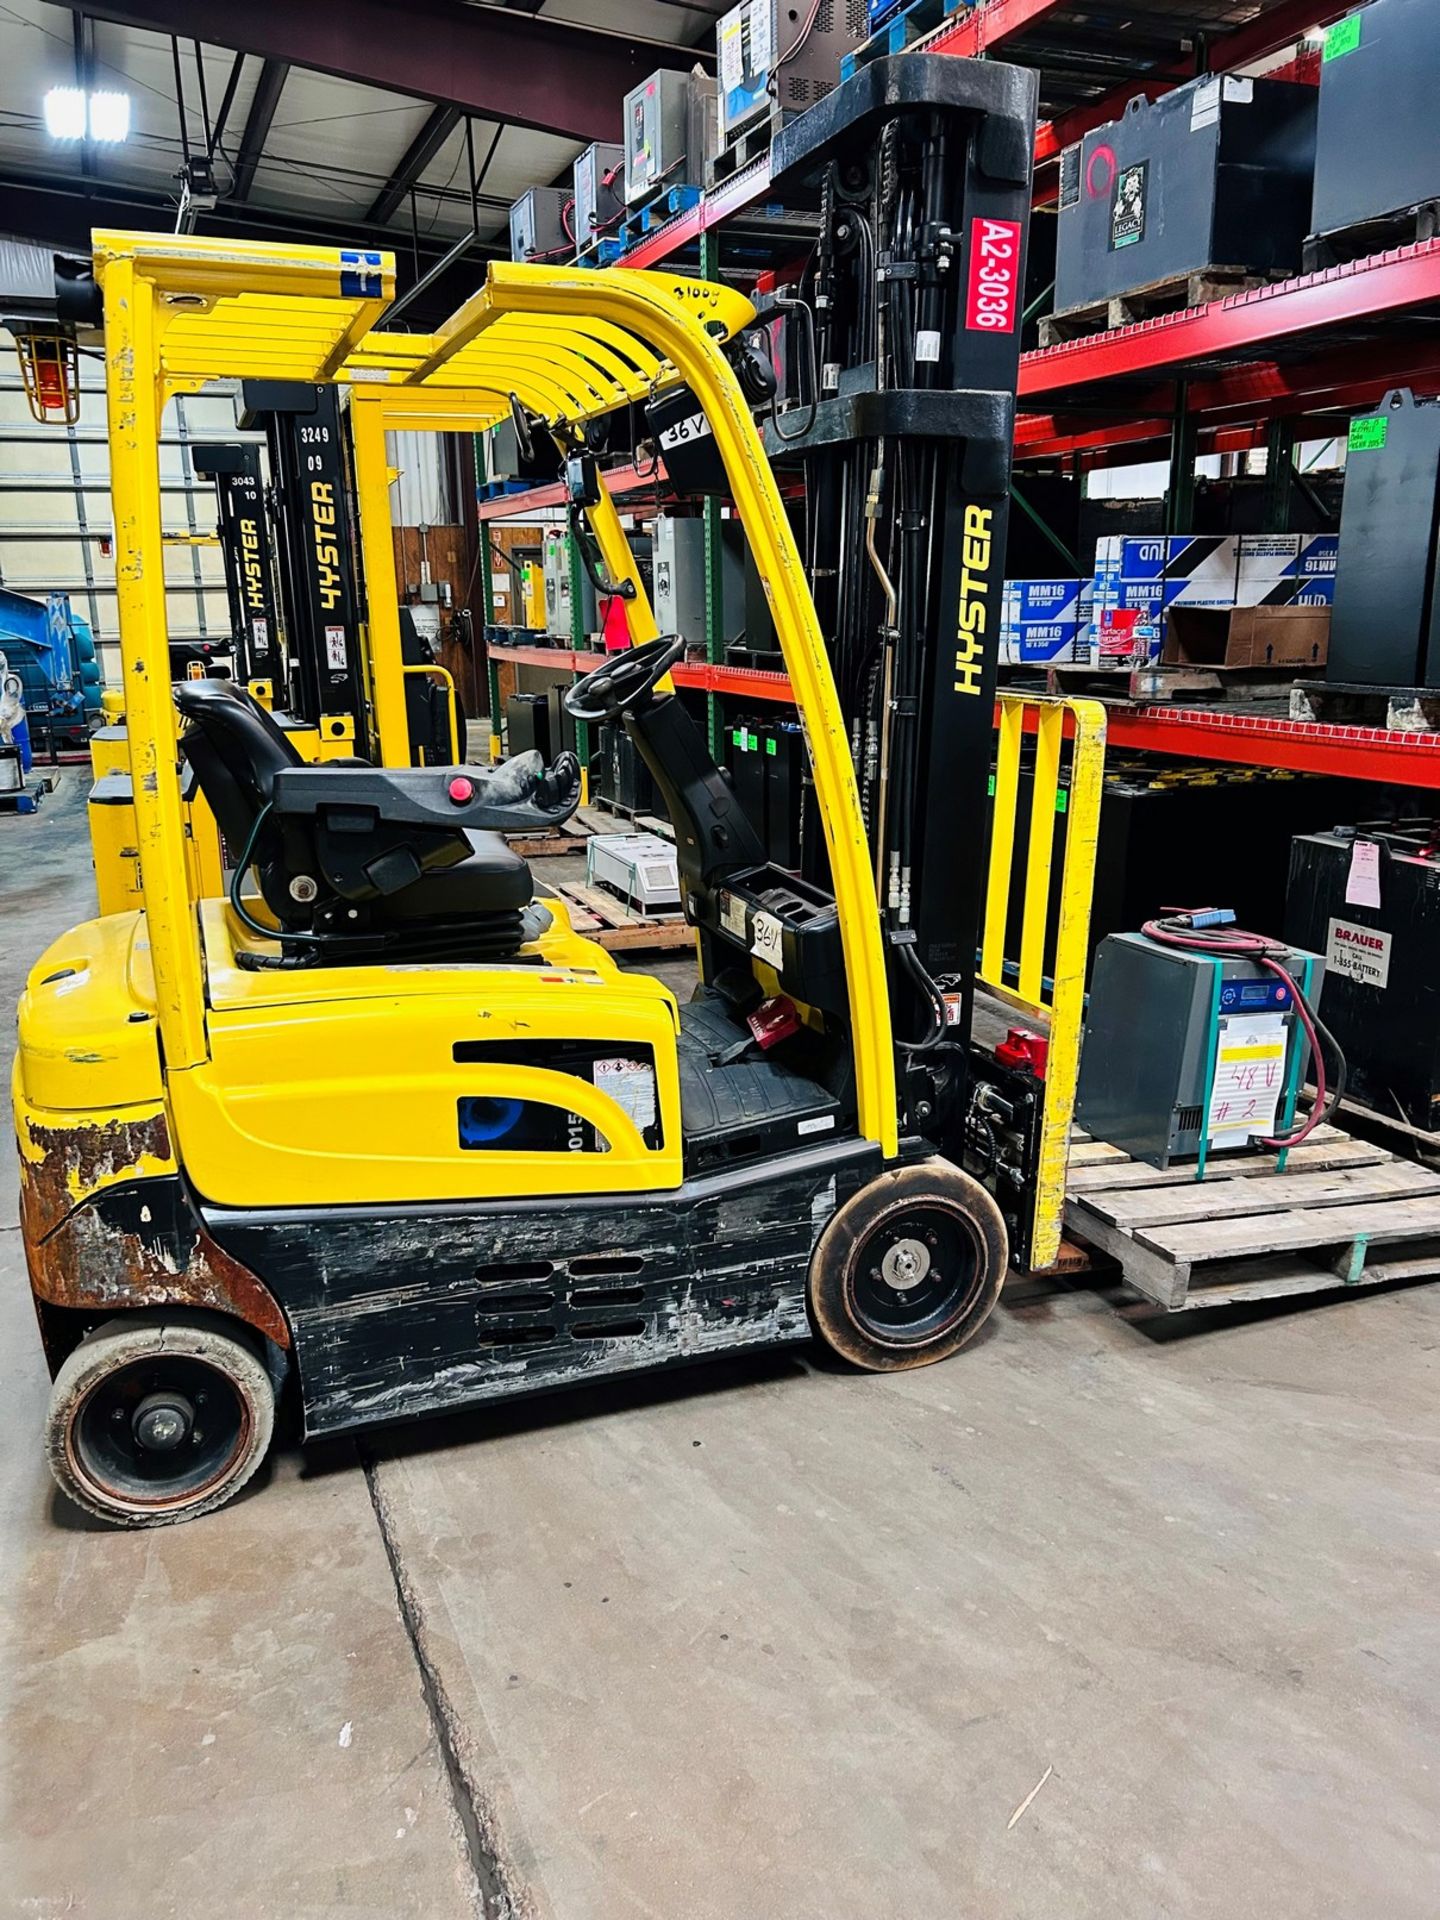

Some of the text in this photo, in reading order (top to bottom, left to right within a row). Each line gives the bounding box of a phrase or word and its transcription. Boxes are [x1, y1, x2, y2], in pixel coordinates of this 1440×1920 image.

[975, 220, 1014, 328] A2-3036
[301, 427, 329, 443] 3249
[668, 413, 704, 442] 36 V
[307, 455, 323, 471] 09
[231, 476, 255, 486] 3043
[245, 491, 257, 500] 10
[240, 518, 264, 608] HYSTER
[954, 504, 992, 696] HYSTER
[1028, 585, 1065, 597] MM16
[1126, 585, 1163, 597] MM16
[1026, 626, 1063, 638] MM16
[1335, 927, 1384, 951] BRAUER
[1231, 1061, 1277, 1090] 48 V
[1215, 1098, 1257, 1121] # 2
[568, 1114, 583, 1152] 015
